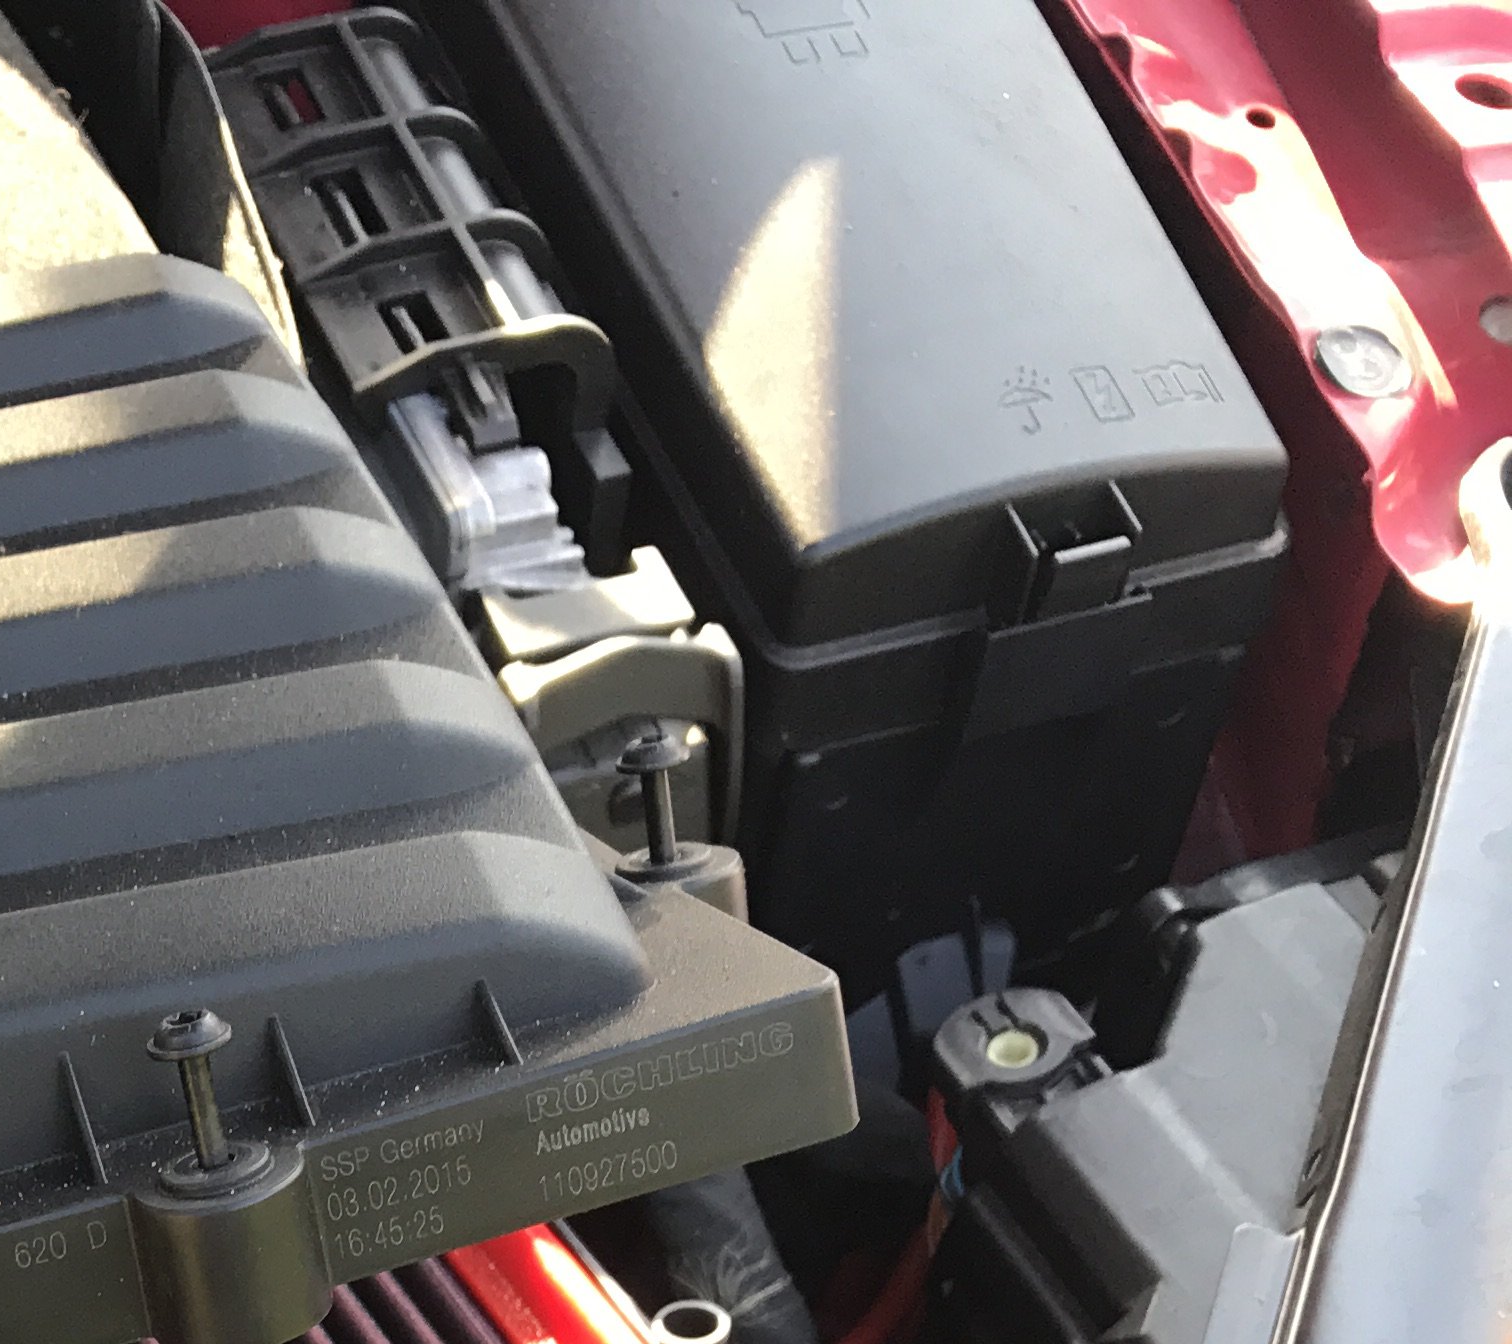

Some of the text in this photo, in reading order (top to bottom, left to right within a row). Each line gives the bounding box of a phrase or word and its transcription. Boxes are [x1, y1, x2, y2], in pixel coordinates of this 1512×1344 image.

[524, 1015, 796, 1124] RÖCHLING
[319, 1112, 486, 1182] SSP Germany
[532, 1100, 652, 1158] Automotive
[537, 1137, 679, 1206] 110927500
[13, 1229, 68, 1269] 620
[86, 1218, 109, 1250] D
[334, 1204, 446, 1263] 16:45:25
